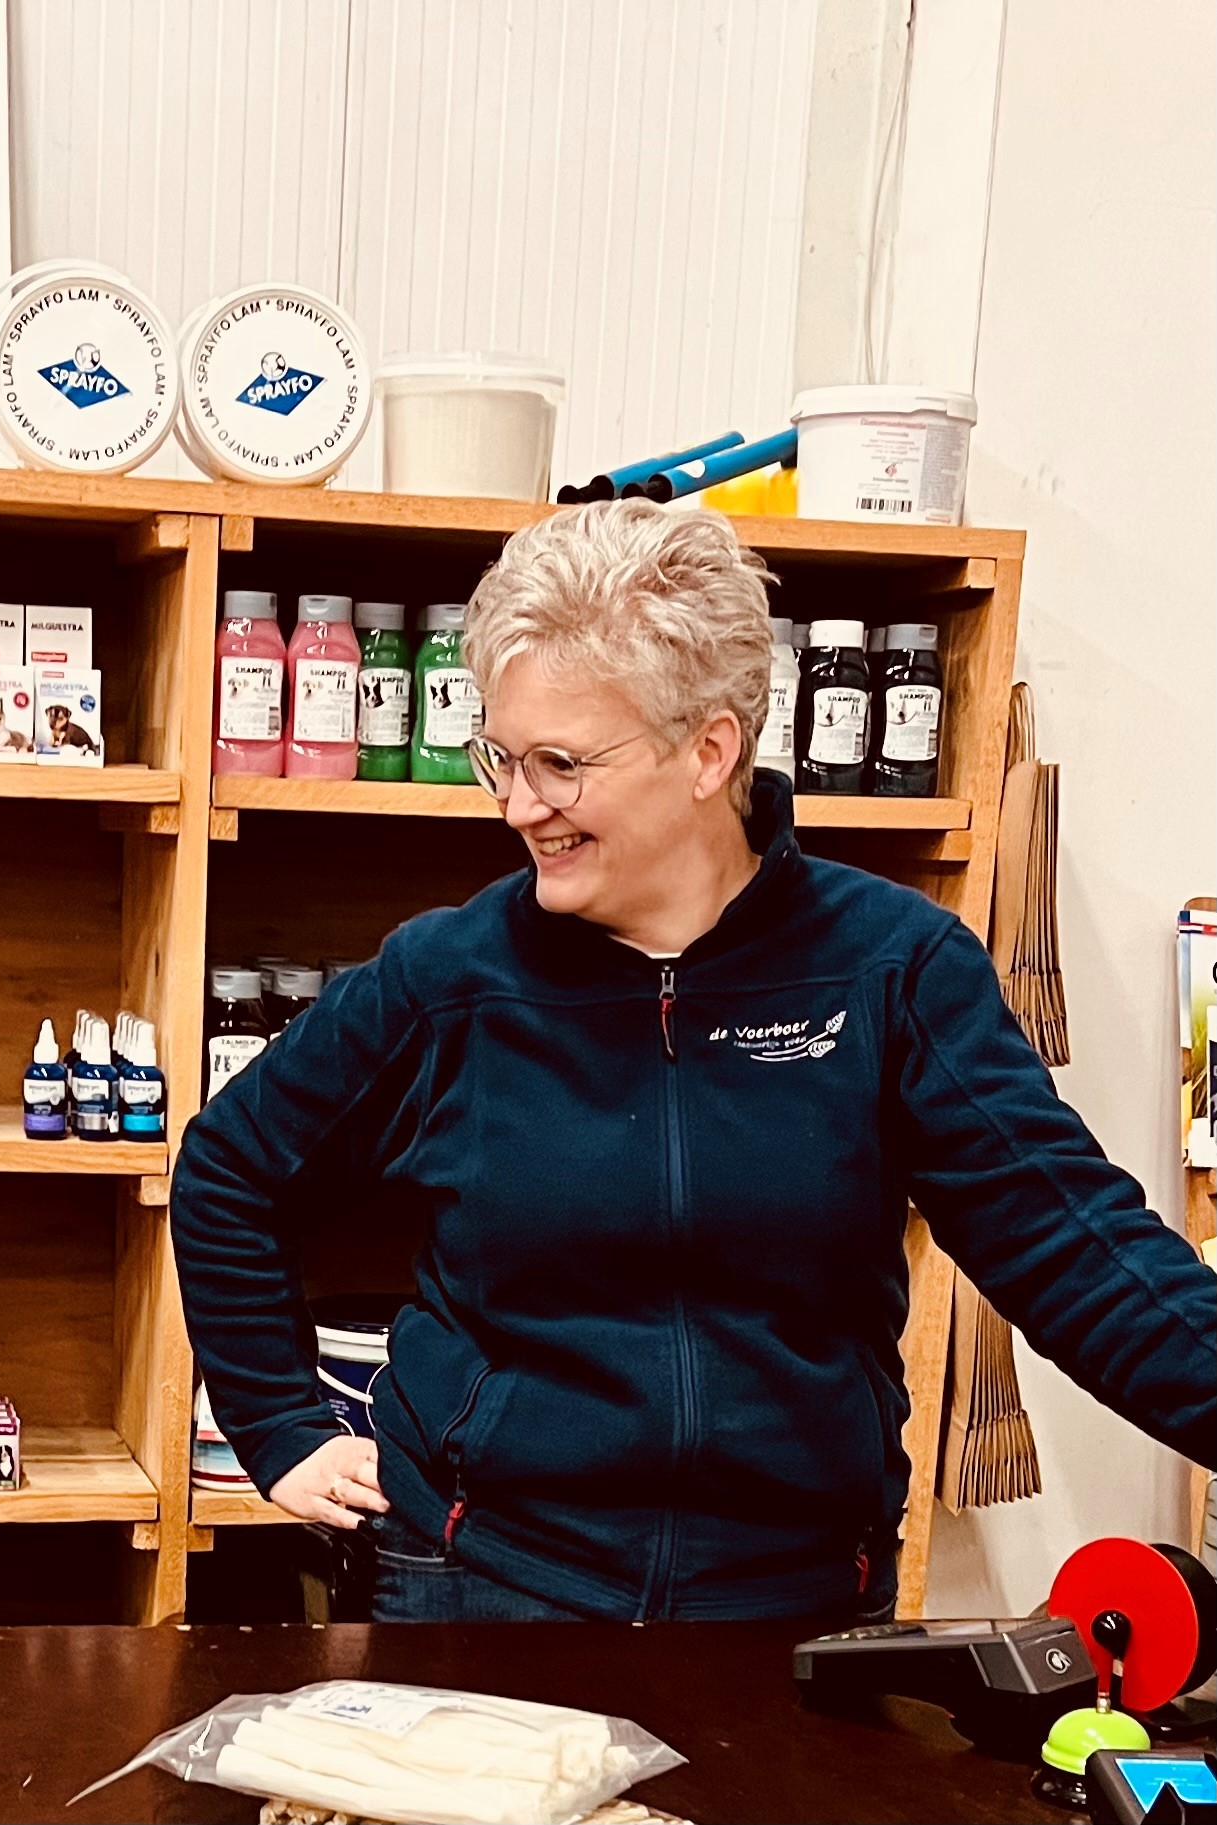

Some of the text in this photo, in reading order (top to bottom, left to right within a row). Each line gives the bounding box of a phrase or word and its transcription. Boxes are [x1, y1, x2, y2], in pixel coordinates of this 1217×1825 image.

[10, 288, 99, 342] SPRAYFO LAM
[197, 300, 261, 384] SPRAYFO LAM
[276, 300, 355, 370] SPRAYFO LAM
[113, 299, 165, 395] SPRAYFO LAM
[2, 353, 56, 451] SPRAYFO LAM
[50, 367, 118, 396] SPRAYFO
[247, 375, 313, 404] SPRAYFO
[69, 408, 159, 461] SPRAYFO LAM
[200, 396, 279, 467] SPRAYFO LAM
[294, 385, 358, 466] SPRAYFO LAM
[235, 667, 273, 675] SHAMPOO
[828, 695, 861, 703] SHAMPOO
[709, 1020, 810, 1041] de Voerboer
